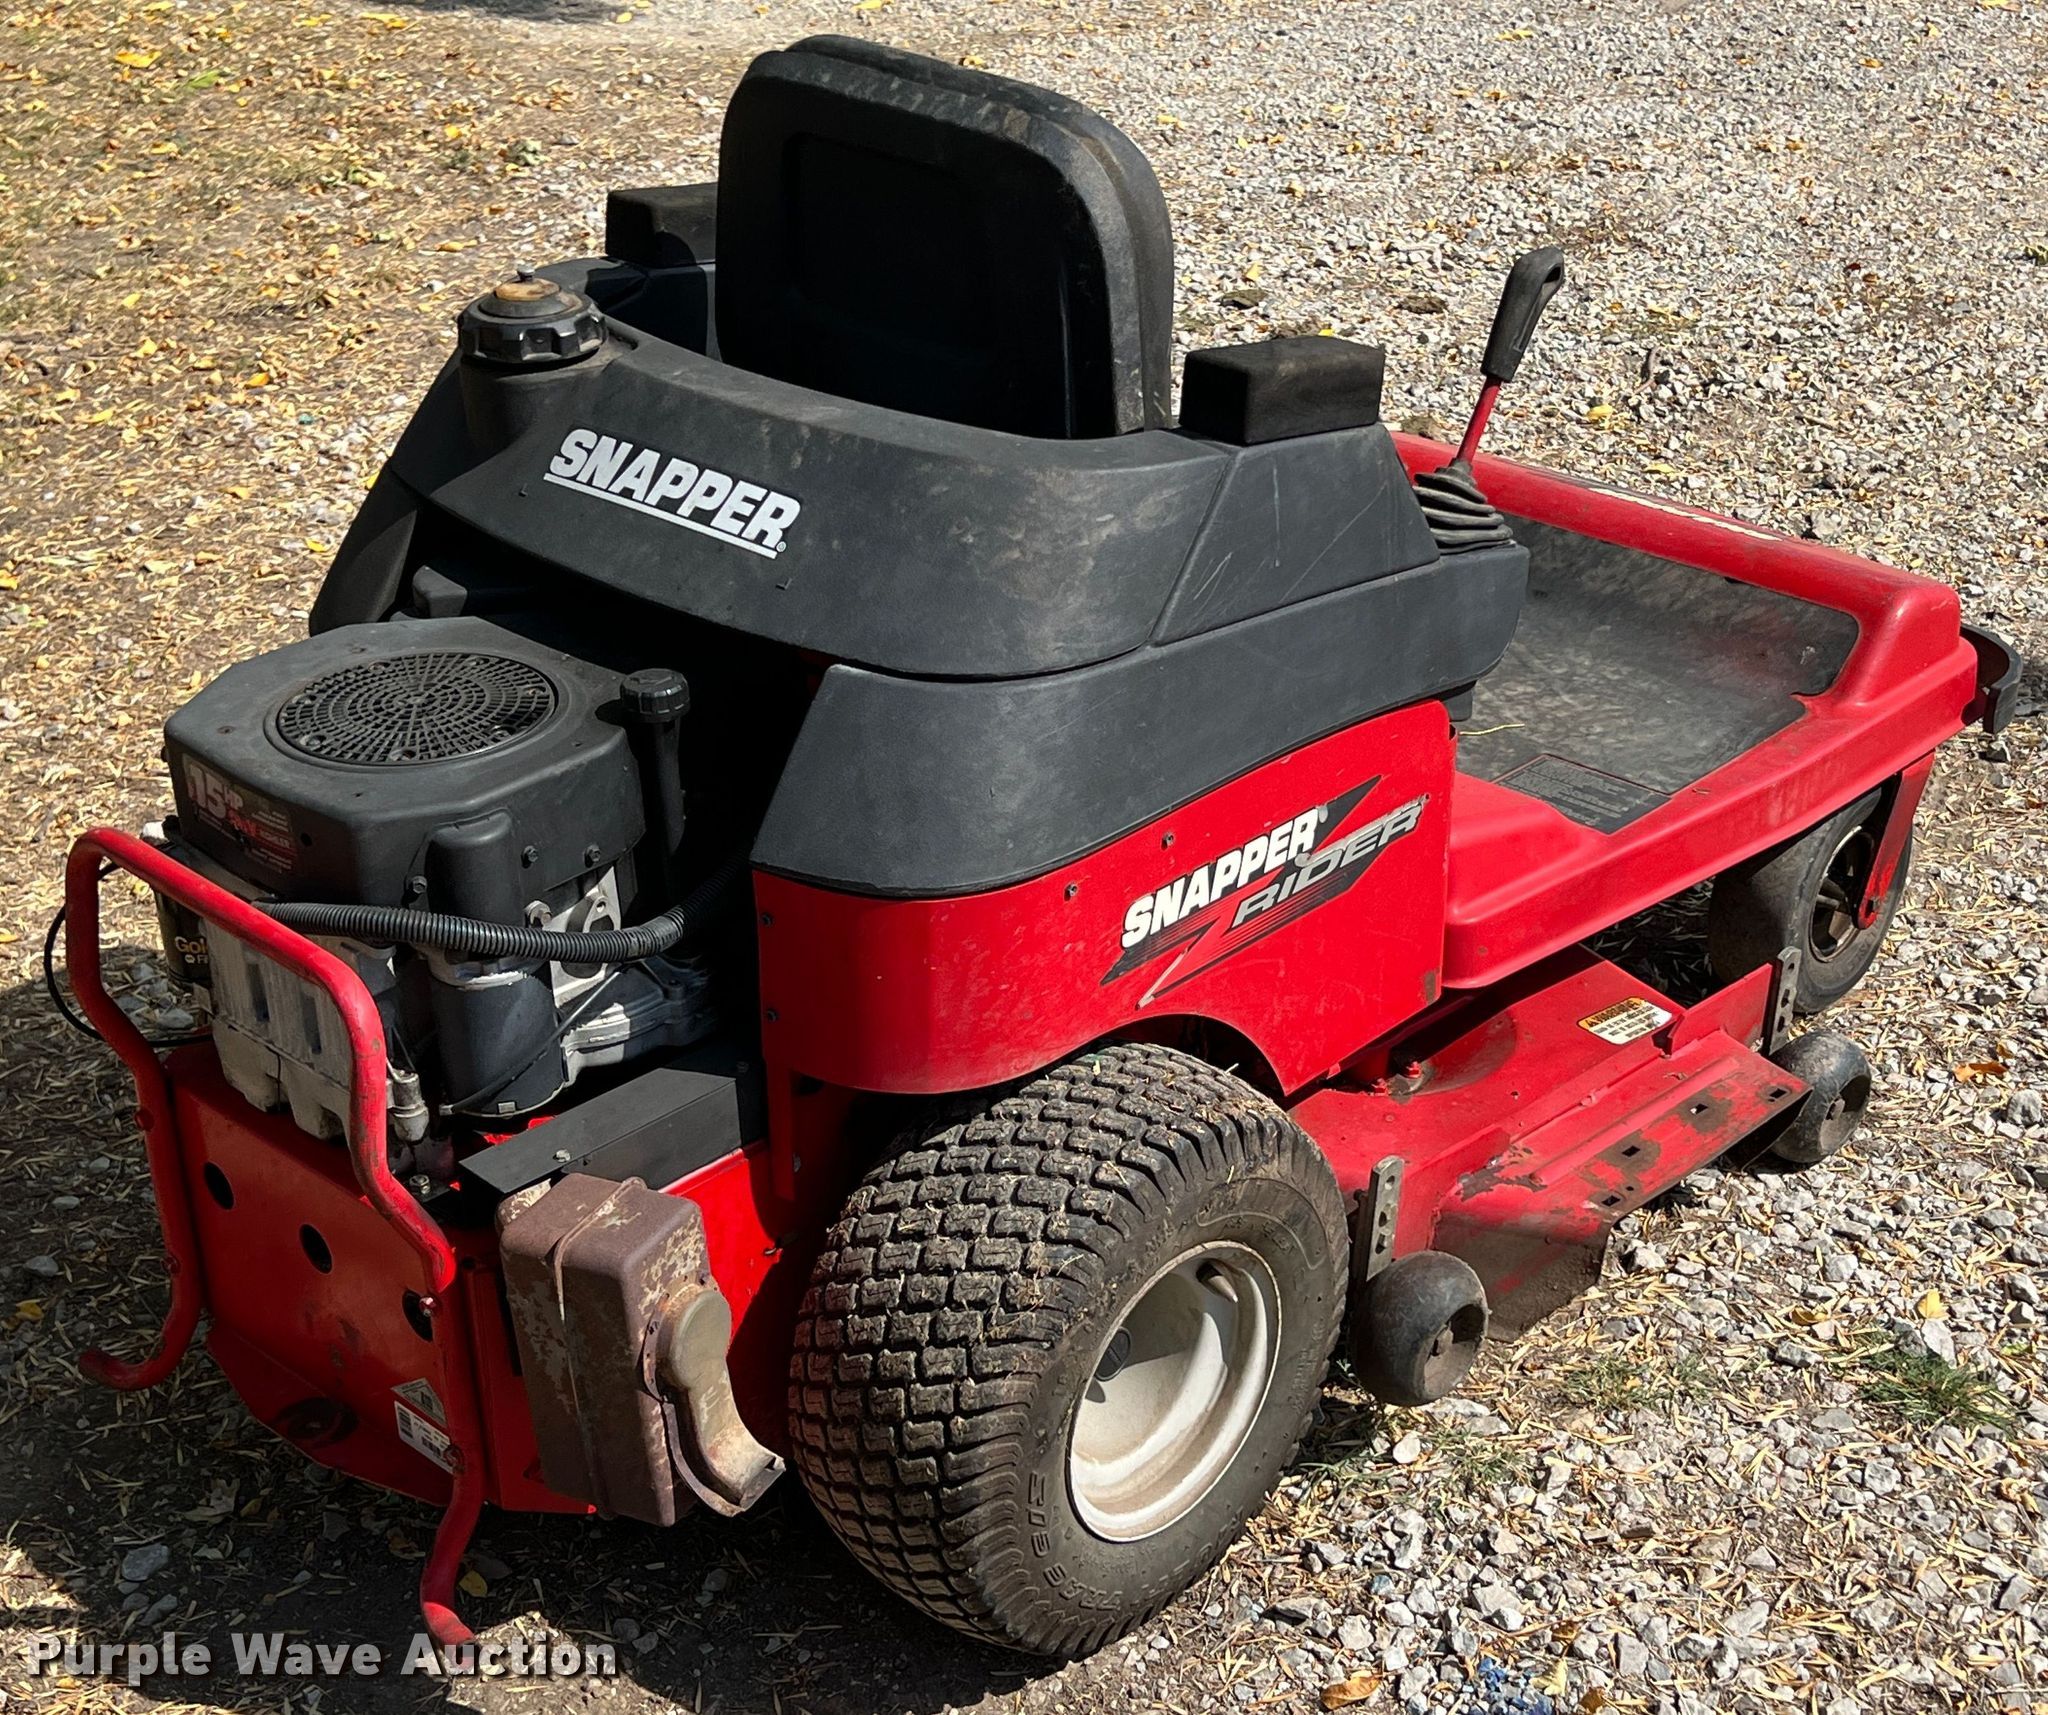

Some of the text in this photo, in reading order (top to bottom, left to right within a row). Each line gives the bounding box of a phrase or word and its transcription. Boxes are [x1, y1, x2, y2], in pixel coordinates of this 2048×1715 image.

[550, 428, 801, 549] SNAPPER
[188, 763, 227, 819] 15
[1121, 807, 1318, 949] SNAPPER
[1231, 802, 1423, 928] RIDER
